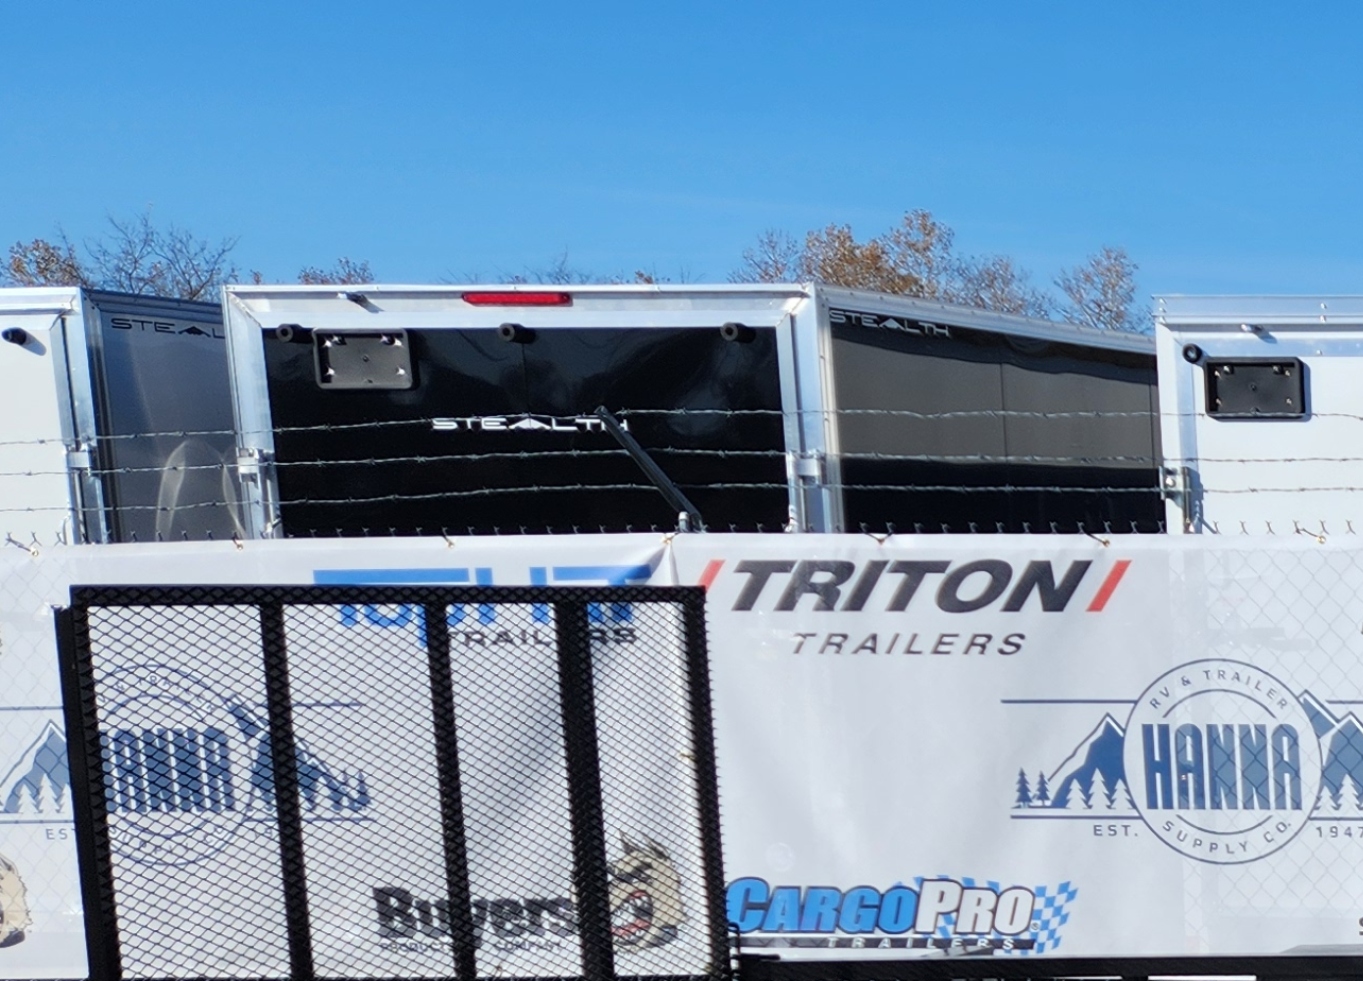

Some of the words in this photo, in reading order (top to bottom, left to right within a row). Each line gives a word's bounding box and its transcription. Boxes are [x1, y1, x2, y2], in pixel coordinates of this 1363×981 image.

[111, 318, 225, 339] STEAL
[829, 310, 949, 336] STEALTH
[730, 559, 1092, 613] TRITON
[793, 632, 1028, 656] TRAILERS
[1149, 687, 1170, 709] RV
[1181, 676, 1192, 686] &
[1203, 669, 1287, 709] TRAILER
[1141, 722, 1302, 810] HANNA
[1094, 825, 1139, 837] EST.
[1162, 820, 1248, 854] SUPPLY
[1263, 821, 1291, 843] CO.
[827, 938, 1014, 949] TRAILERS
